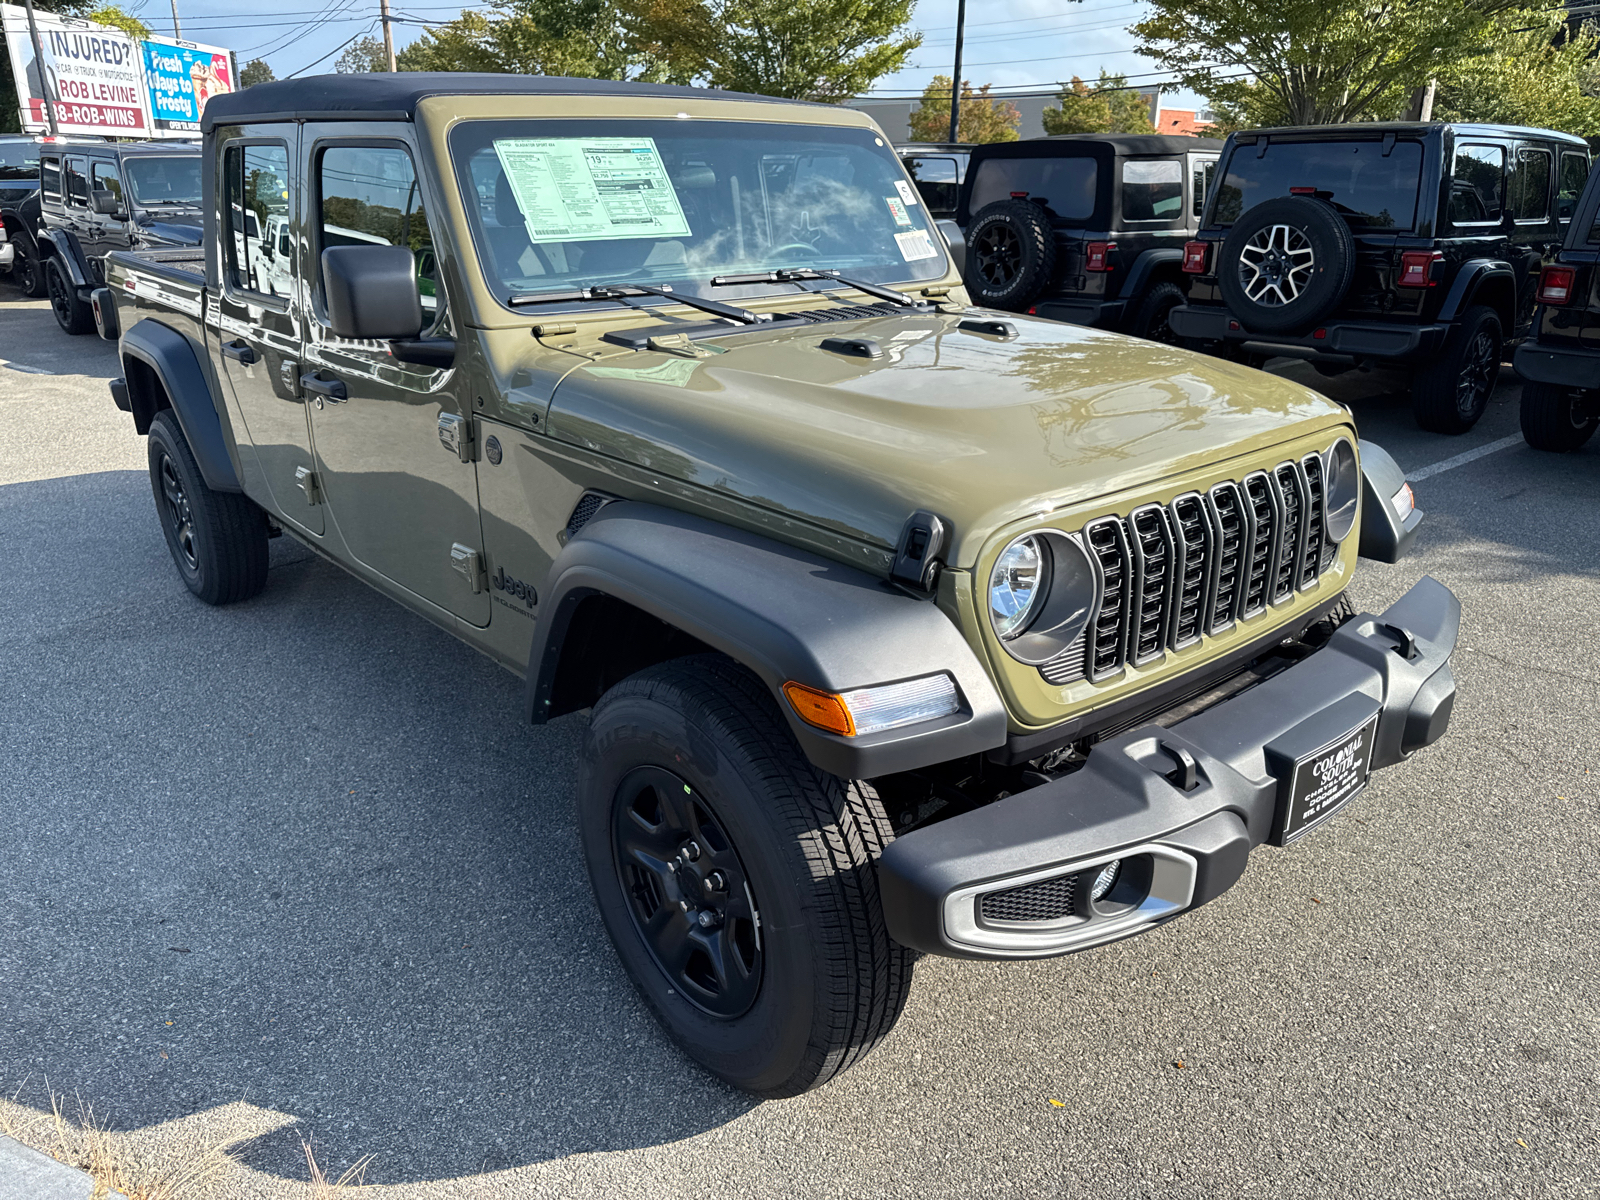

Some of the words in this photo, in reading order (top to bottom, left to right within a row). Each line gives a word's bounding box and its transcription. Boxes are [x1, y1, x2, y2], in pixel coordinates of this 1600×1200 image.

[49, 29, 130, 67] INJURED?
[61, 64, 72, 74] CAR
[80, 66, 97, 77] TRUCK
[104, 69, 134, 82] MOTORCYCLE
[151, 51, 184, 74] Fresh
[59, 79, 90, 99] ROB
[91, 83, 137, 104] LEVINE
[147, 70, 180, 97] Ways
[179, 76, 193, 94] to
[155, 92, 193, 118] Frosty
[590, 155, 602, 164] 19
[492, 565, 538, 609] Jeep
[500, 598, 538, 621] GLADIATO
[1312, 734, 1363, 777] COLONIAL
[1320, 753, 1355, 786] SOUTH
[1304, 770, 1349, 802] CHRYSLER
[1309, 785, 1338, 807] DODGE
